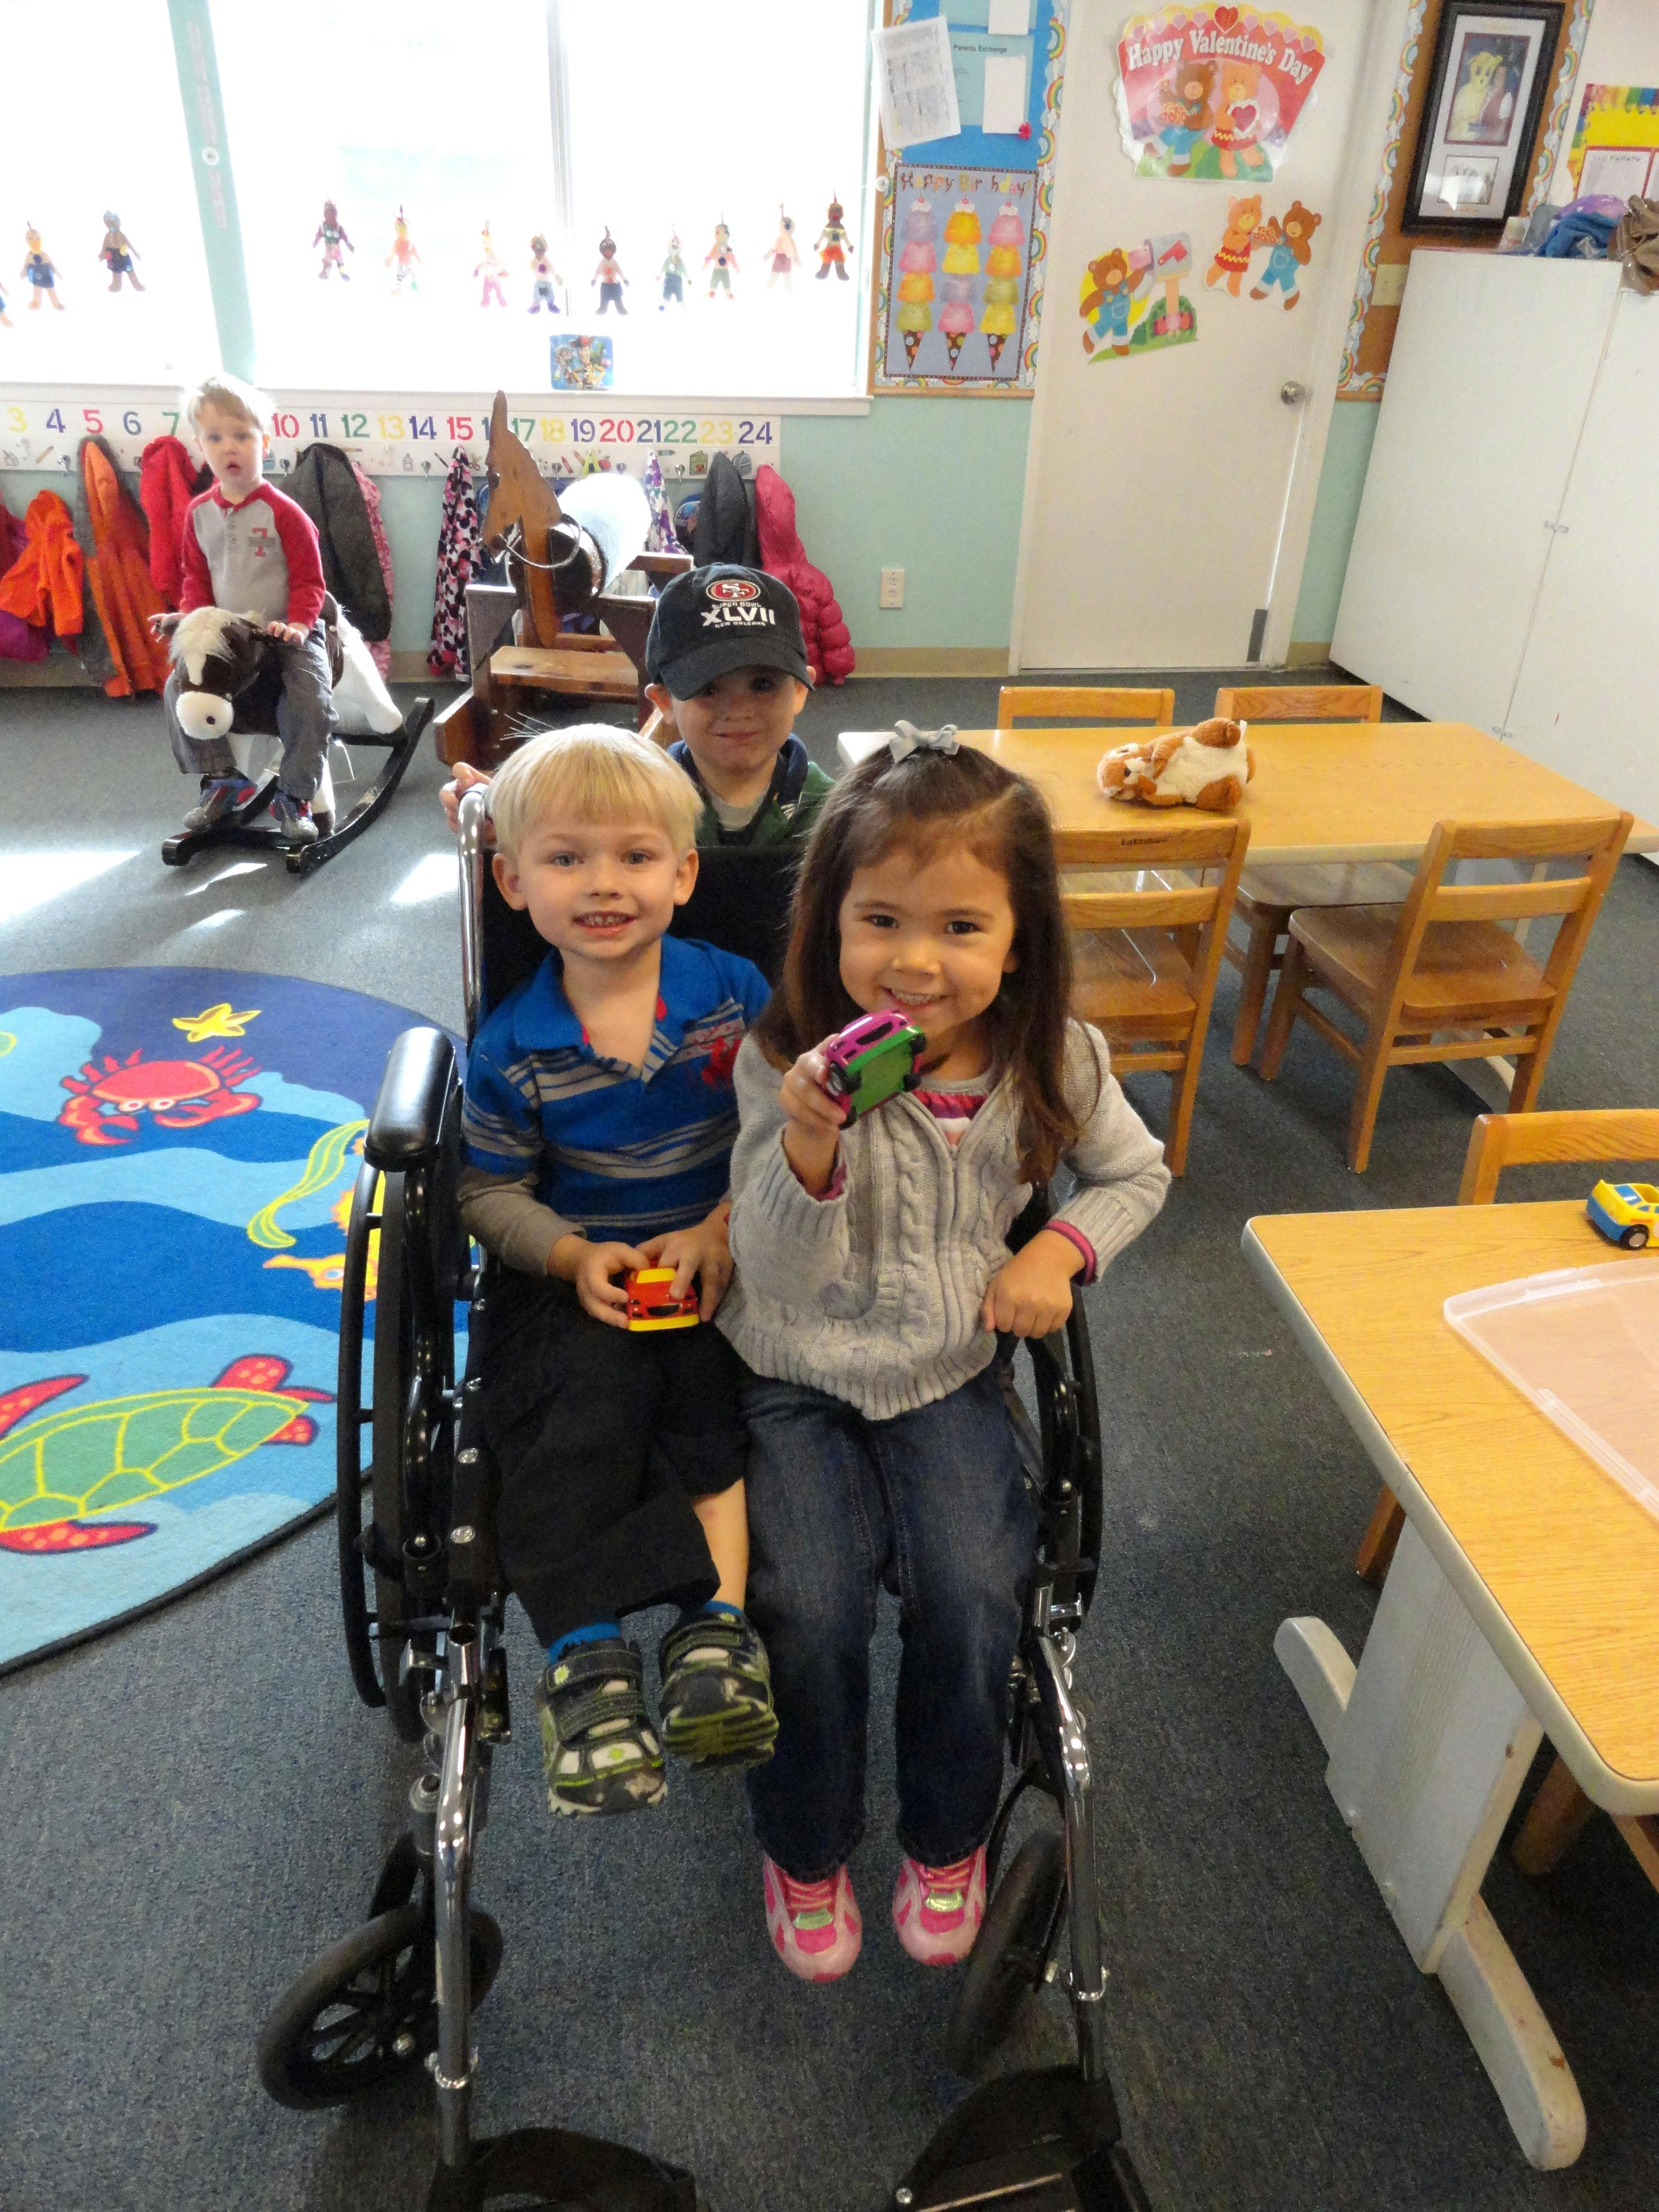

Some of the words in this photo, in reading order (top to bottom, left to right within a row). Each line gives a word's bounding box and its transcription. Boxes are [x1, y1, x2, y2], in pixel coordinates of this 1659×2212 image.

[953, 44, 976, 52] Parents
[978, 46, 1008, 54] Exchange
[1127, 37, 1184, 71] Happy
[1190, 30, 1276, 65] Valentine's
[1278, 48, 1313, 84] Day
[901, 171, 954, 193] Happy
[7, 407, 27, 433] 3
[46, 409, 66, 433] 4
[83, 409, 103, 434] 5
[123, 411, 142, 435] 6
[162, 412, 180, 435] 7
[272, 413, 300, 438] 10
[310, 414, 330, 438] 11
[341, 413, 370, 438] 12
[378, 415, 404, 440] 13
[409, 416, 437, 440] 14
[446, 416, 473, 441] 15
[511, 418, 535, 442] 17
[540, 418, 566, 444] 18
[571, 419, 595, 443] 19
[599, 419, 635, 443] 20
[637, 420, 661, 443] 21
[664, 420, 697, 444] 22
[699, 420, 734, 445] 23
[738, 421, 772, 445] 24
[701, 607, 775, 626] XLVII
